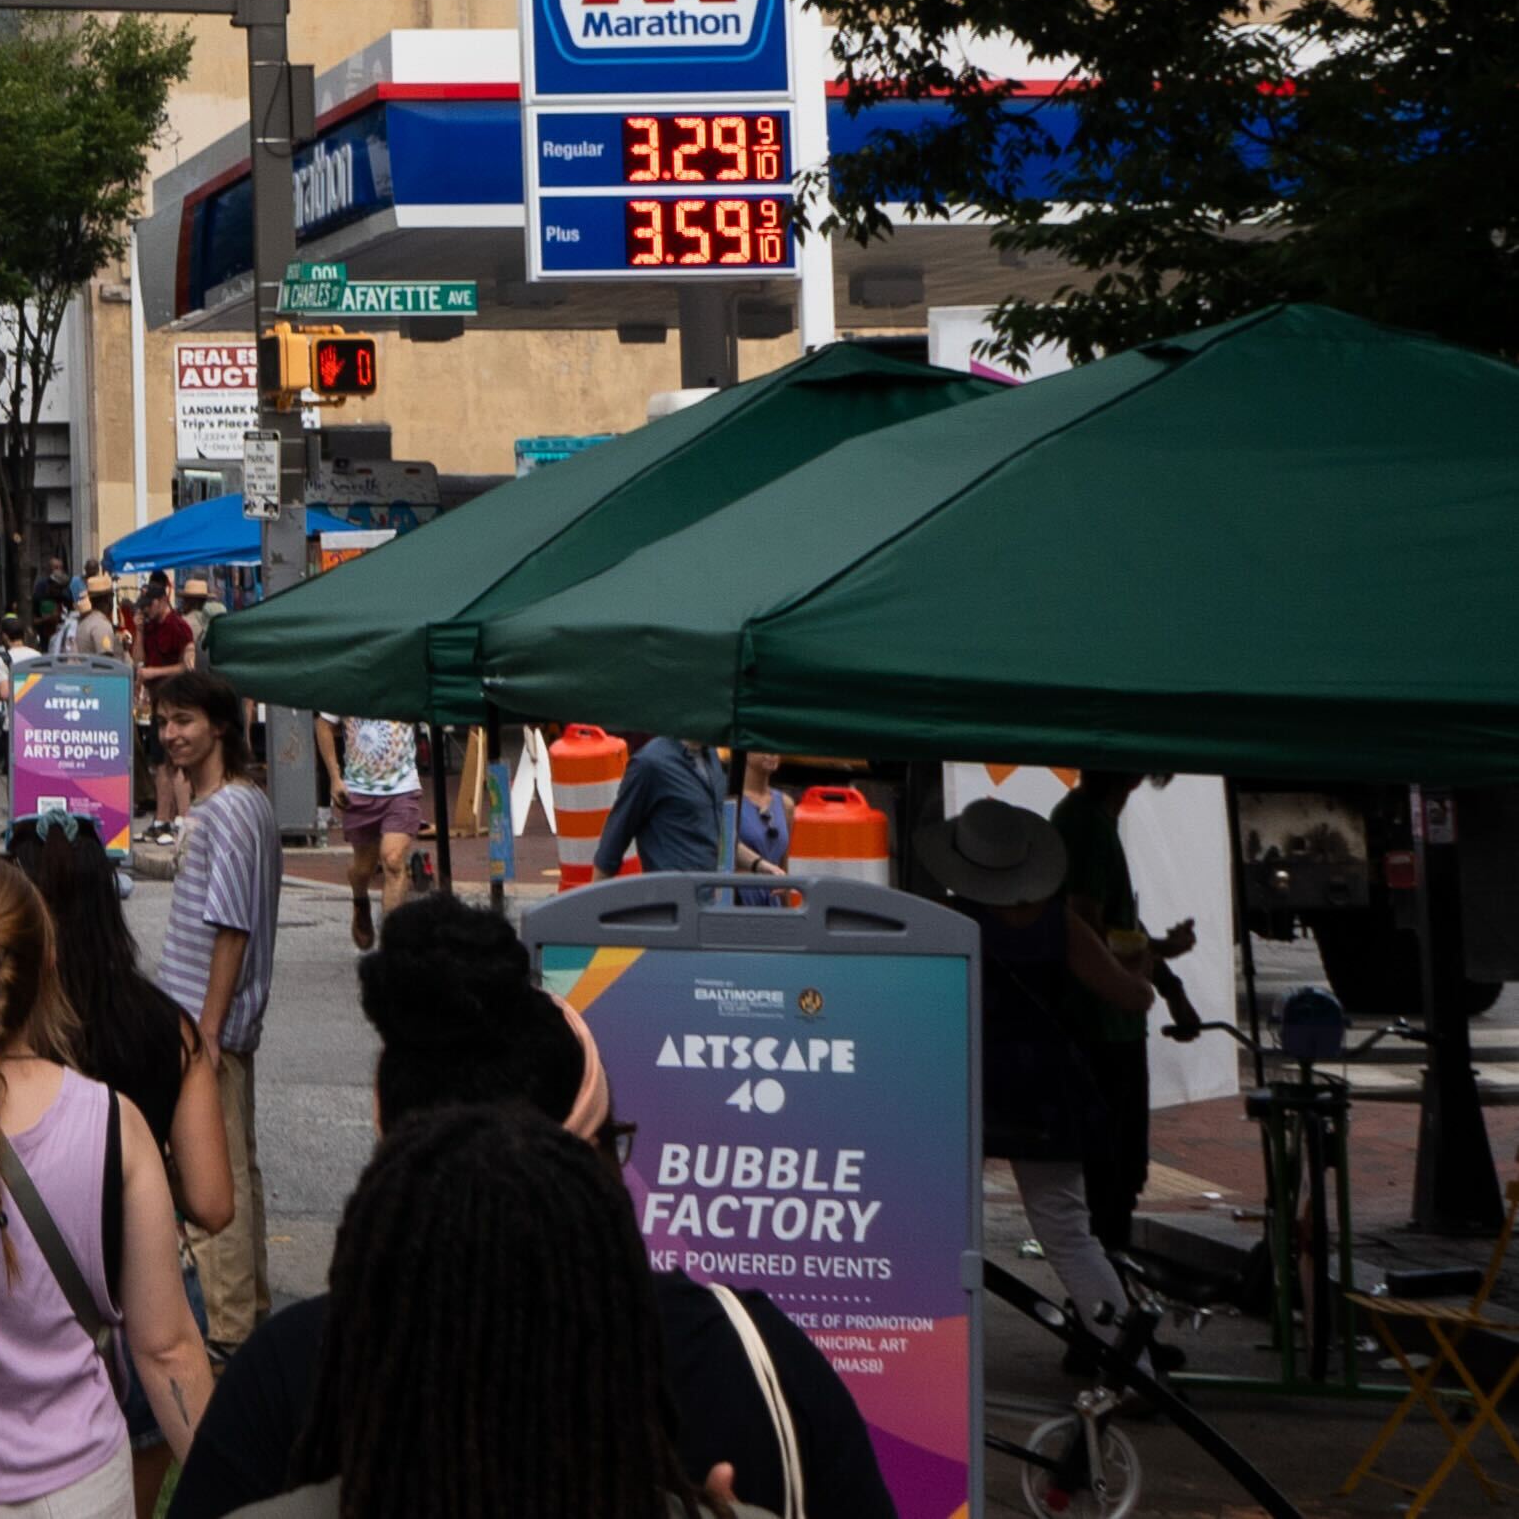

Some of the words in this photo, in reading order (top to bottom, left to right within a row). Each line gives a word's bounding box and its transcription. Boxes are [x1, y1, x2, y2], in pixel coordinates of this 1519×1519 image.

[582, 11, 741, 37] Marathon
[543, 141, 605, 159] Regular
[627, 117, 749, 181] 3.29
[546, 226, 580, 242] Plus
[630, 200, 751, 264] 3.59
[290, 282, 331, 307] CHARLES
[337, 286, 442, 311] AFAYETTE
[447, 290, 473, 306] AVE
[181, 348, 232, 366] REAL
[236, 348, 258, 366] ES
[181, 367, 258, 388] AUCT
[182, 405, 247, 415] LANDMARK
[182, 419, 215, 430] Trip's
[218, 419, 249, 428] Place
[45, 698, 99, 710] ARTSCAPE
[24, 729, 119, 745] PERFORMING
[23, 744, 60, 759] ARTS
[64, 745, 120, 761] POP-UP
[694, 988, 784, 1002] BALTIMORE
[656, 1035, 855, 1073] ARTSCAPE
[725, 1078, 785, 1113] 40
[657, 1143, 865, 1193] BUBBLE
[642, 1192, 882, 1243] FACTORY
[685, 1250, 797, 1276] POWERED
[803, 1255, 892, 1280] EVENTS
[822, 1314, 841, 1330] OF
[845, 1314, 934, 1332] PROMOTION
[879, 1338, 909, 1353] ART
[832, 1357, 884, 1374] (MASB)
